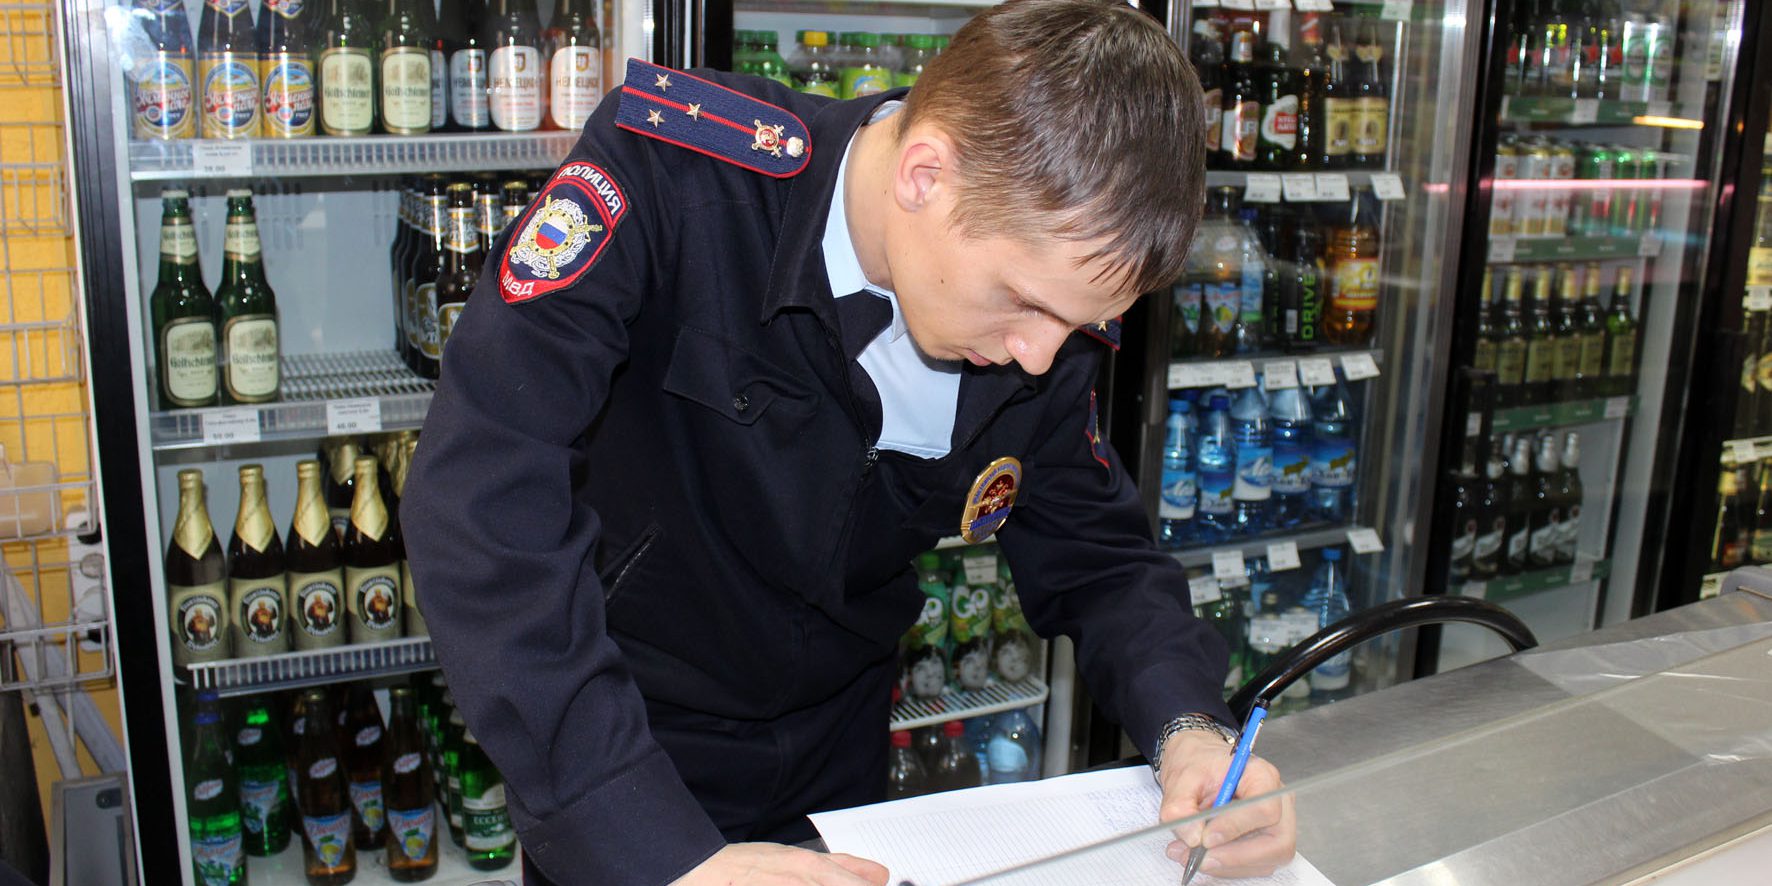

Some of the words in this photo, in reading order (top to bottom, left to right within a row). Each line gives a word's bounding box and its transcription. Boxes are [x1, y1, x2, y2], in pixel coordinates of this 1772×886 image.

[557, 165, 621, 215] ПОЛИЦИЯ
[502, 271, 535, 296] МВД
[1301, 273, 1316, 340] DRIVE
